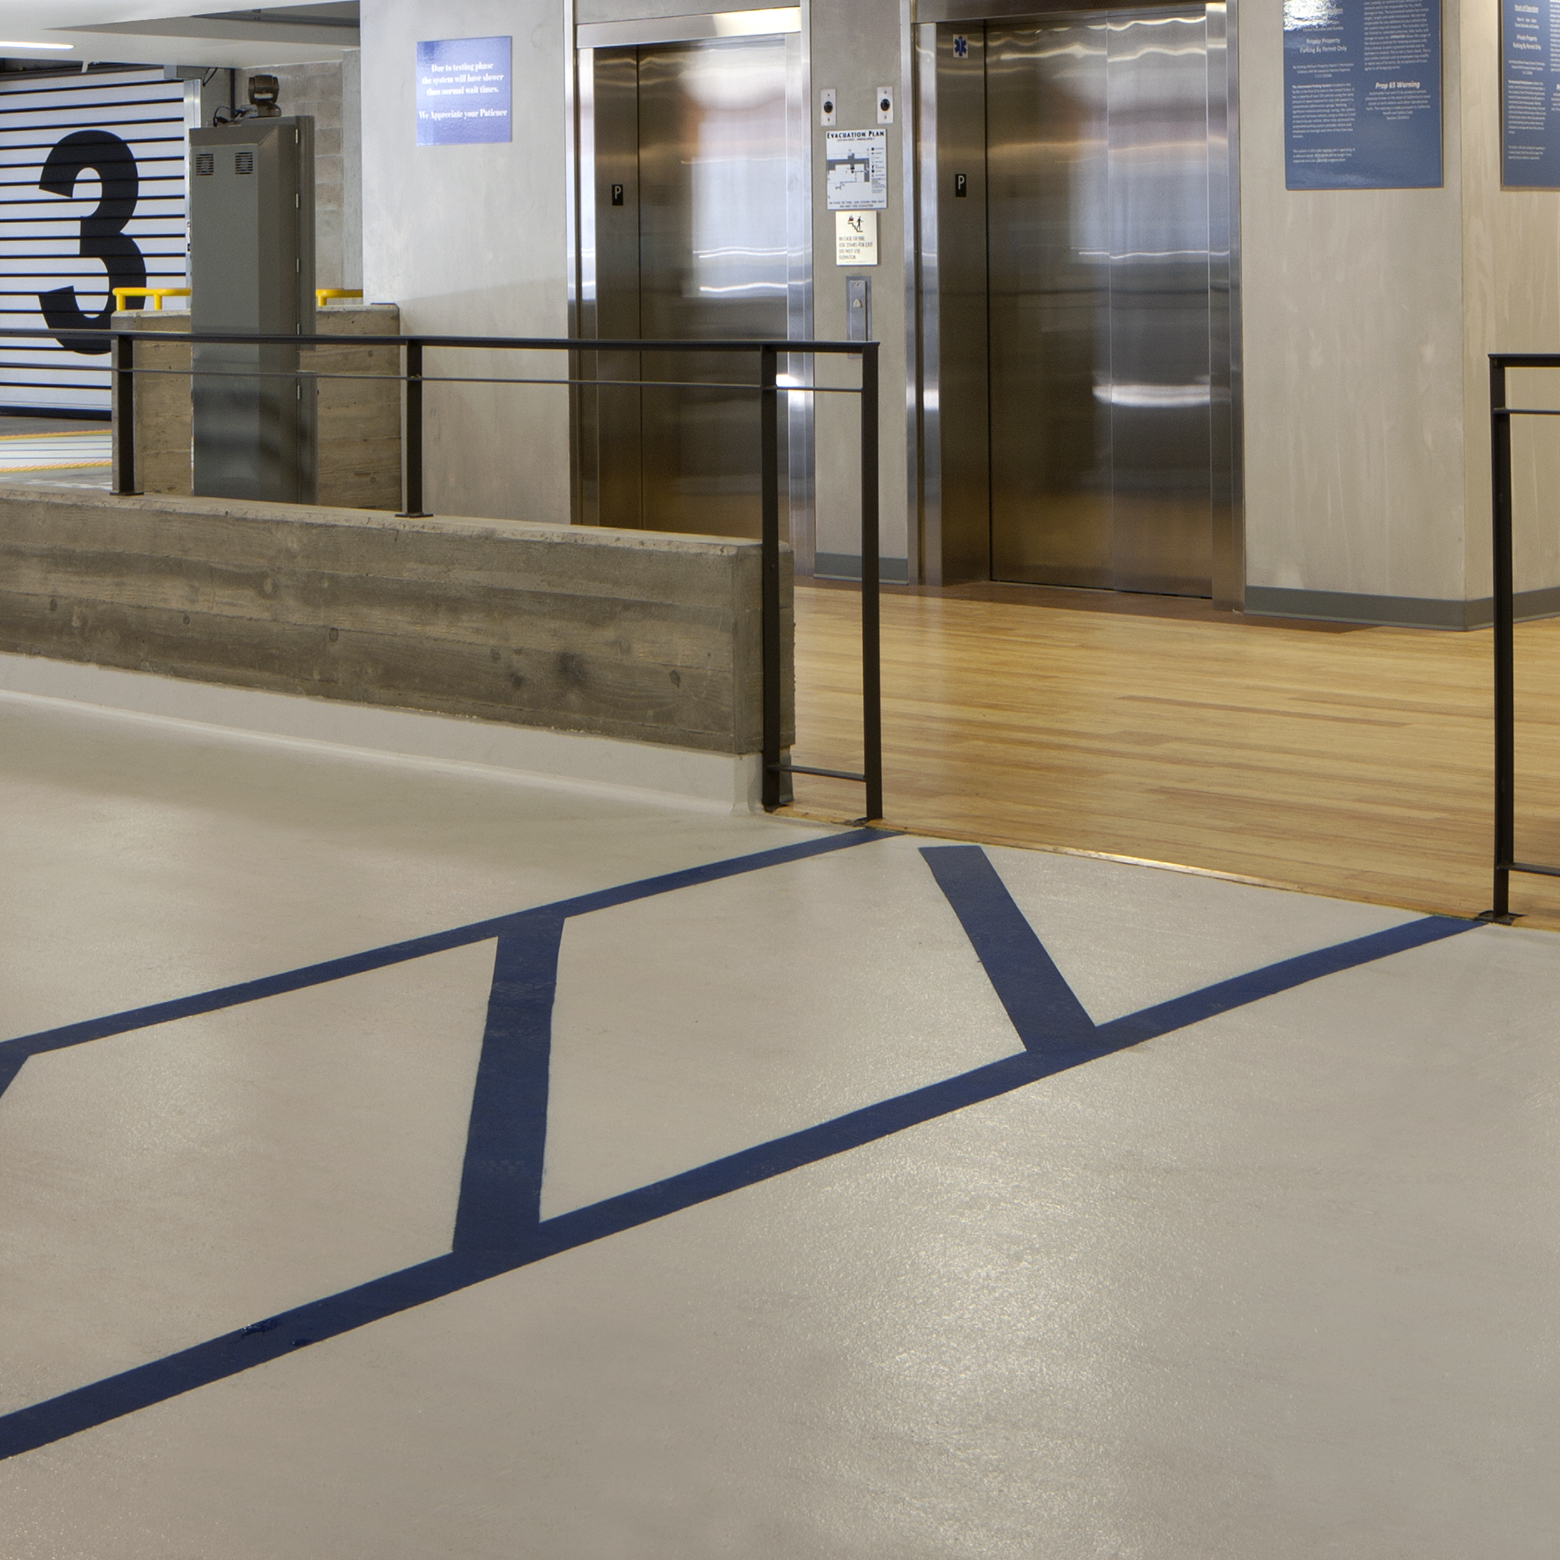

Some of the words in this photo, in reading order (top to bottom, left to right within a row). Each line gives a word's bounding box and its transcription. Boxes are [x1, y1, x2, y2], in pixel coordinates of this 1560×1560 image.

[958, 175, 965, 190] P
[614, 185, 621, 200] P
[38, 129, 147, 355] 3
